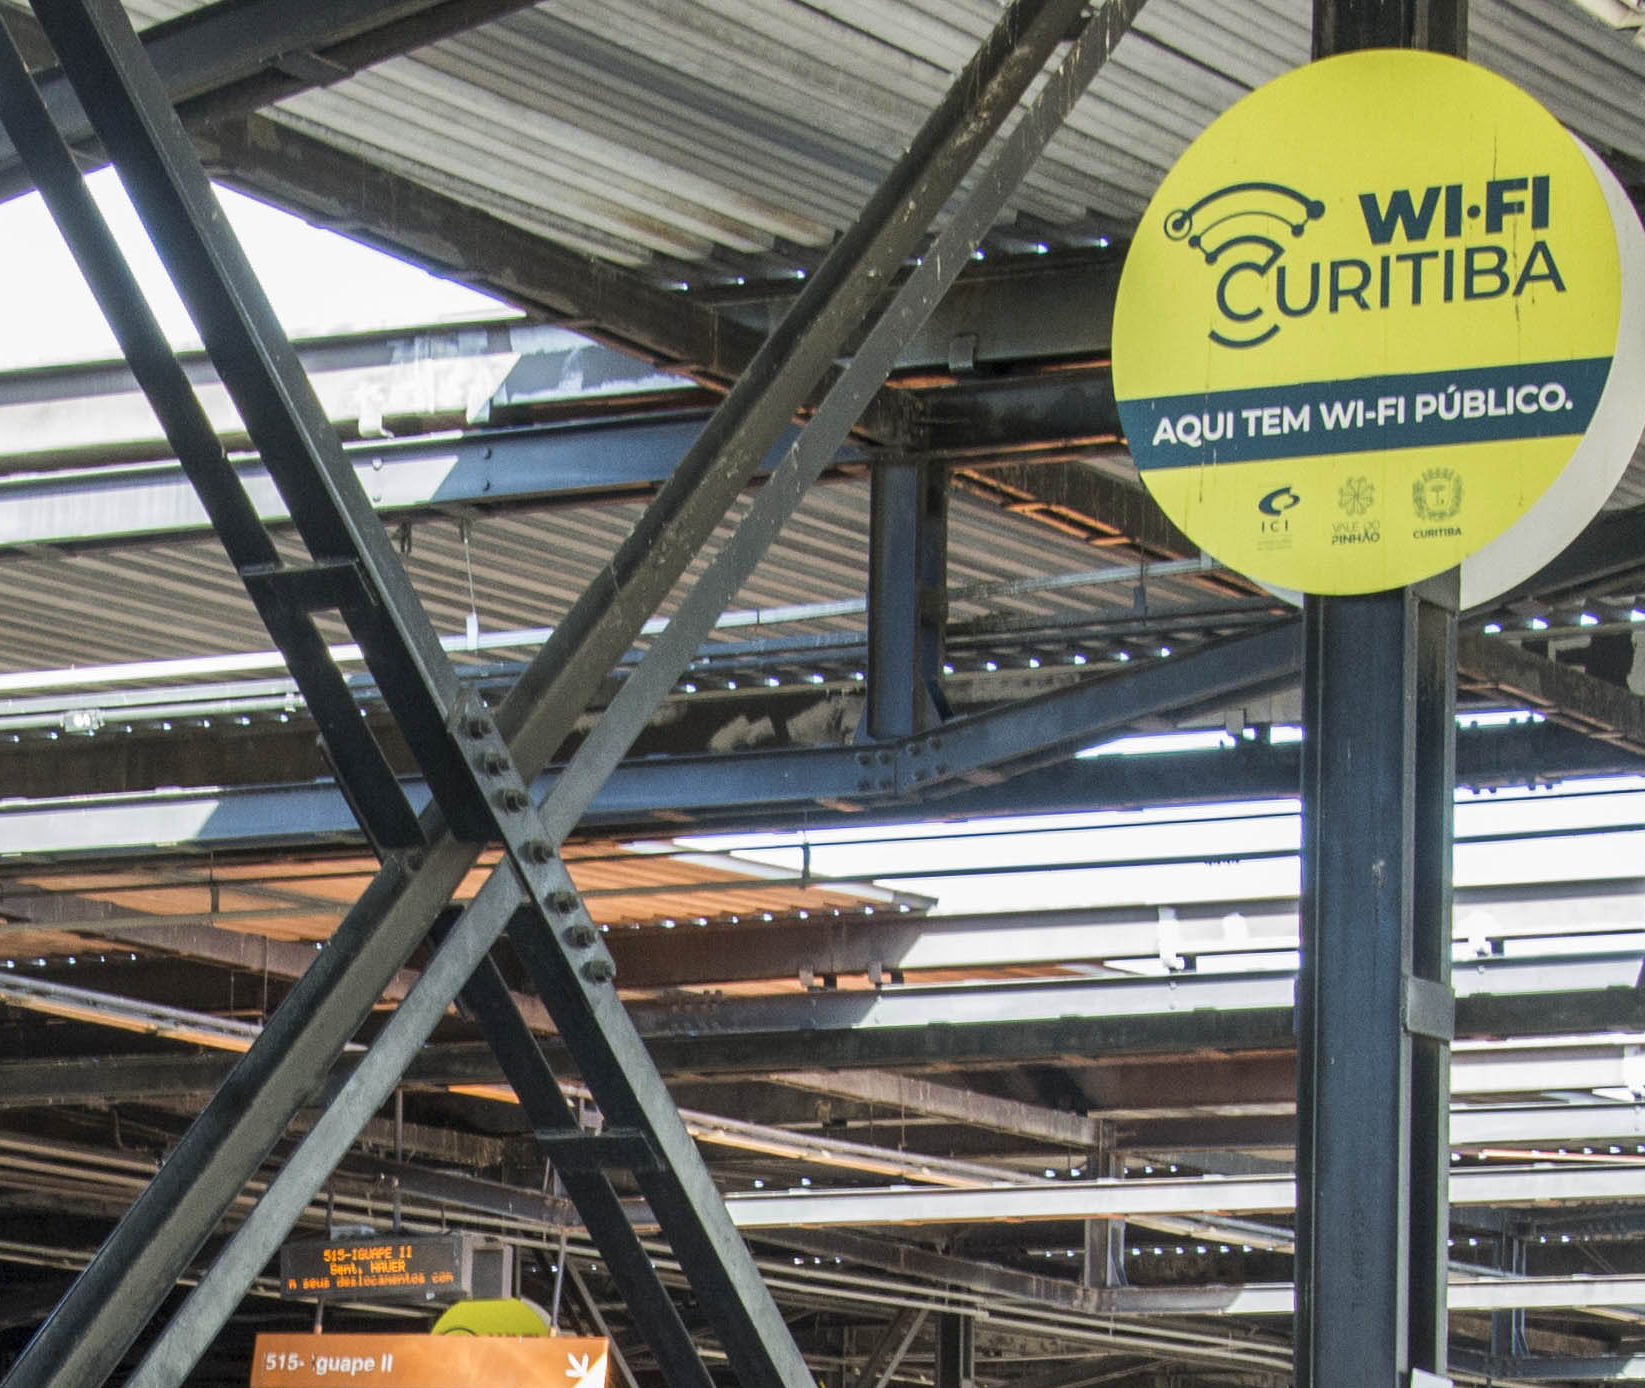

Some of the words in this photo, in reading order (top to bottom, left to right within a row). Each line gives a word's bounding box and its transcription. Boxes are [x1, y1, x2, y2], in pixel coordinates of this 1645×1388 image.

[1216, 240, 1567, 322] CURITIBA
[1152, 411, 1234, 447] AQUI
[1242, 405, 1310, 437] TEM
[1319, 397, 1405, 431] WI-FI
[1416, 382, 1574, 424] PÚBLICO.
[1262, 520, 1289, 534] ICI
[1413, 527, 1462, 540] CURITIBA
[370, 1259, 406, 1273] HAUER
[266, 1352, 305, 1371] 515-
